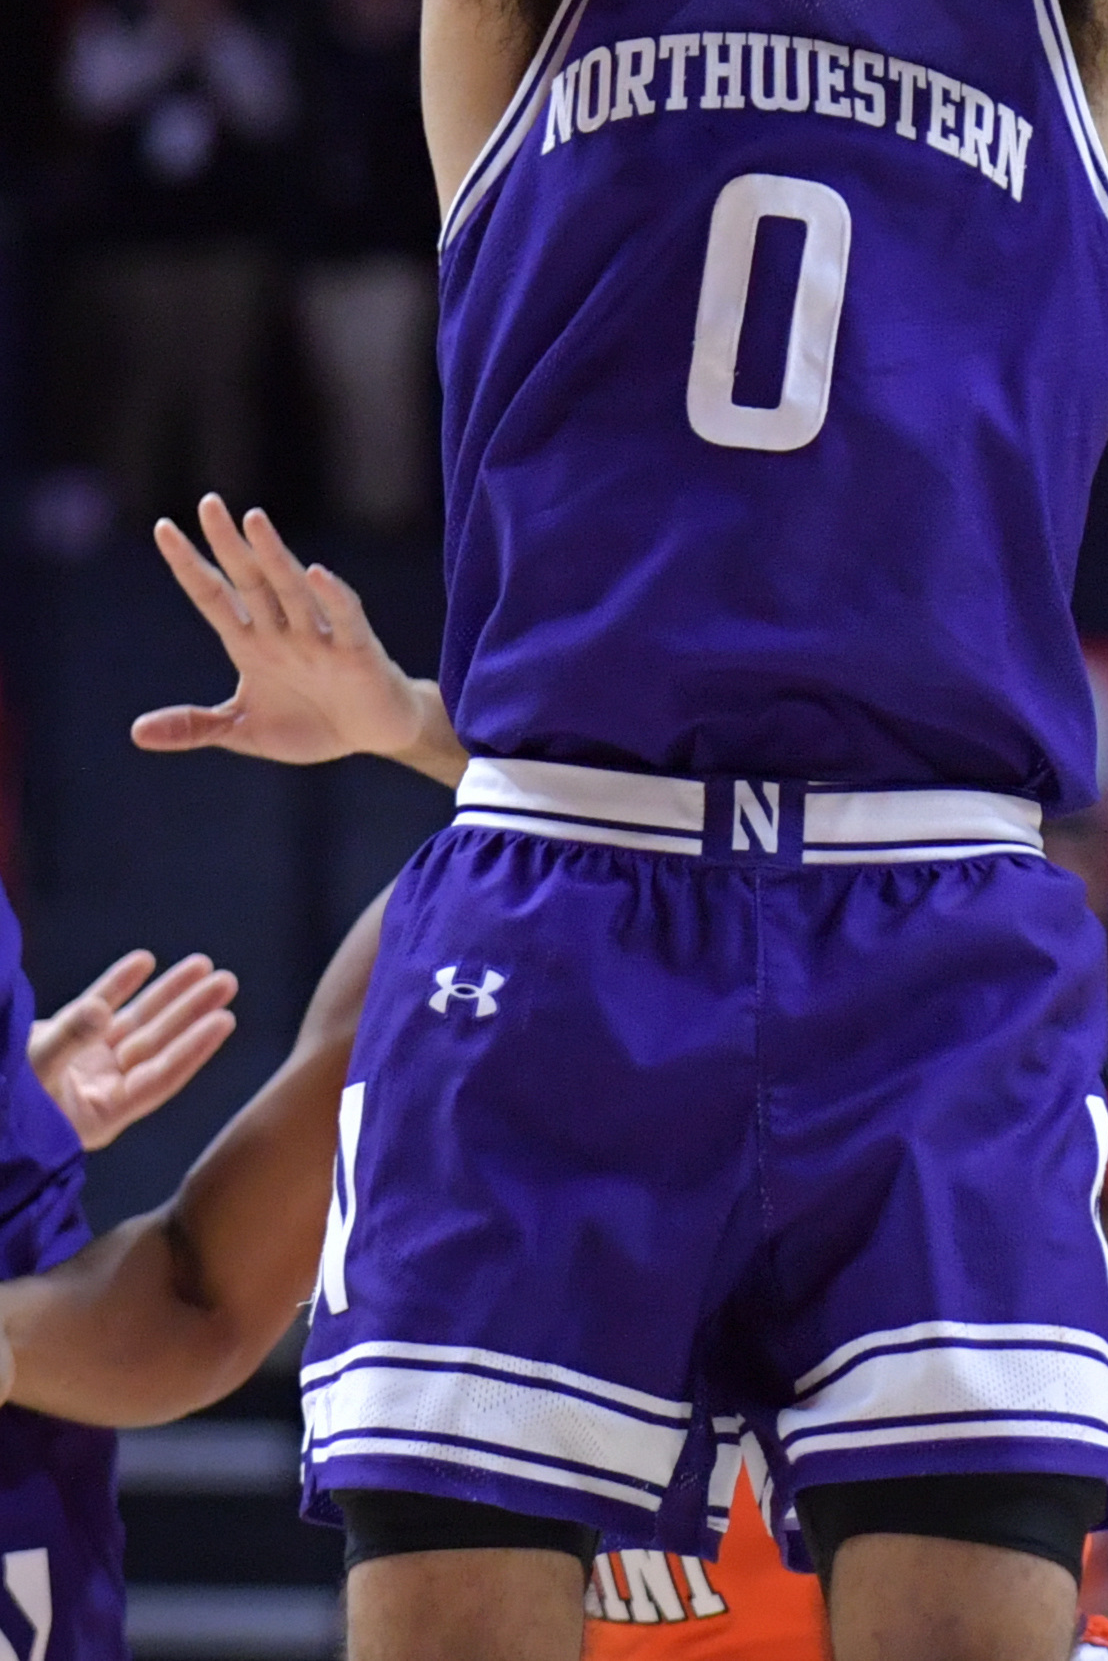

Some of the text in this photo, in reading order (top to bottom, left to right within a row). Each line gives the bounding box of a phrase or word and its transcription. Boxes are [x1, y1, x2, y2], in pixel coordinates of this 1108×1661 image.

[541, 31, 1033, 203] NORTHWESTERN
[686, 172, 852, 453] 0
[731, 779, 780, 854] N
[585, 1549, 729, 1625] INI
